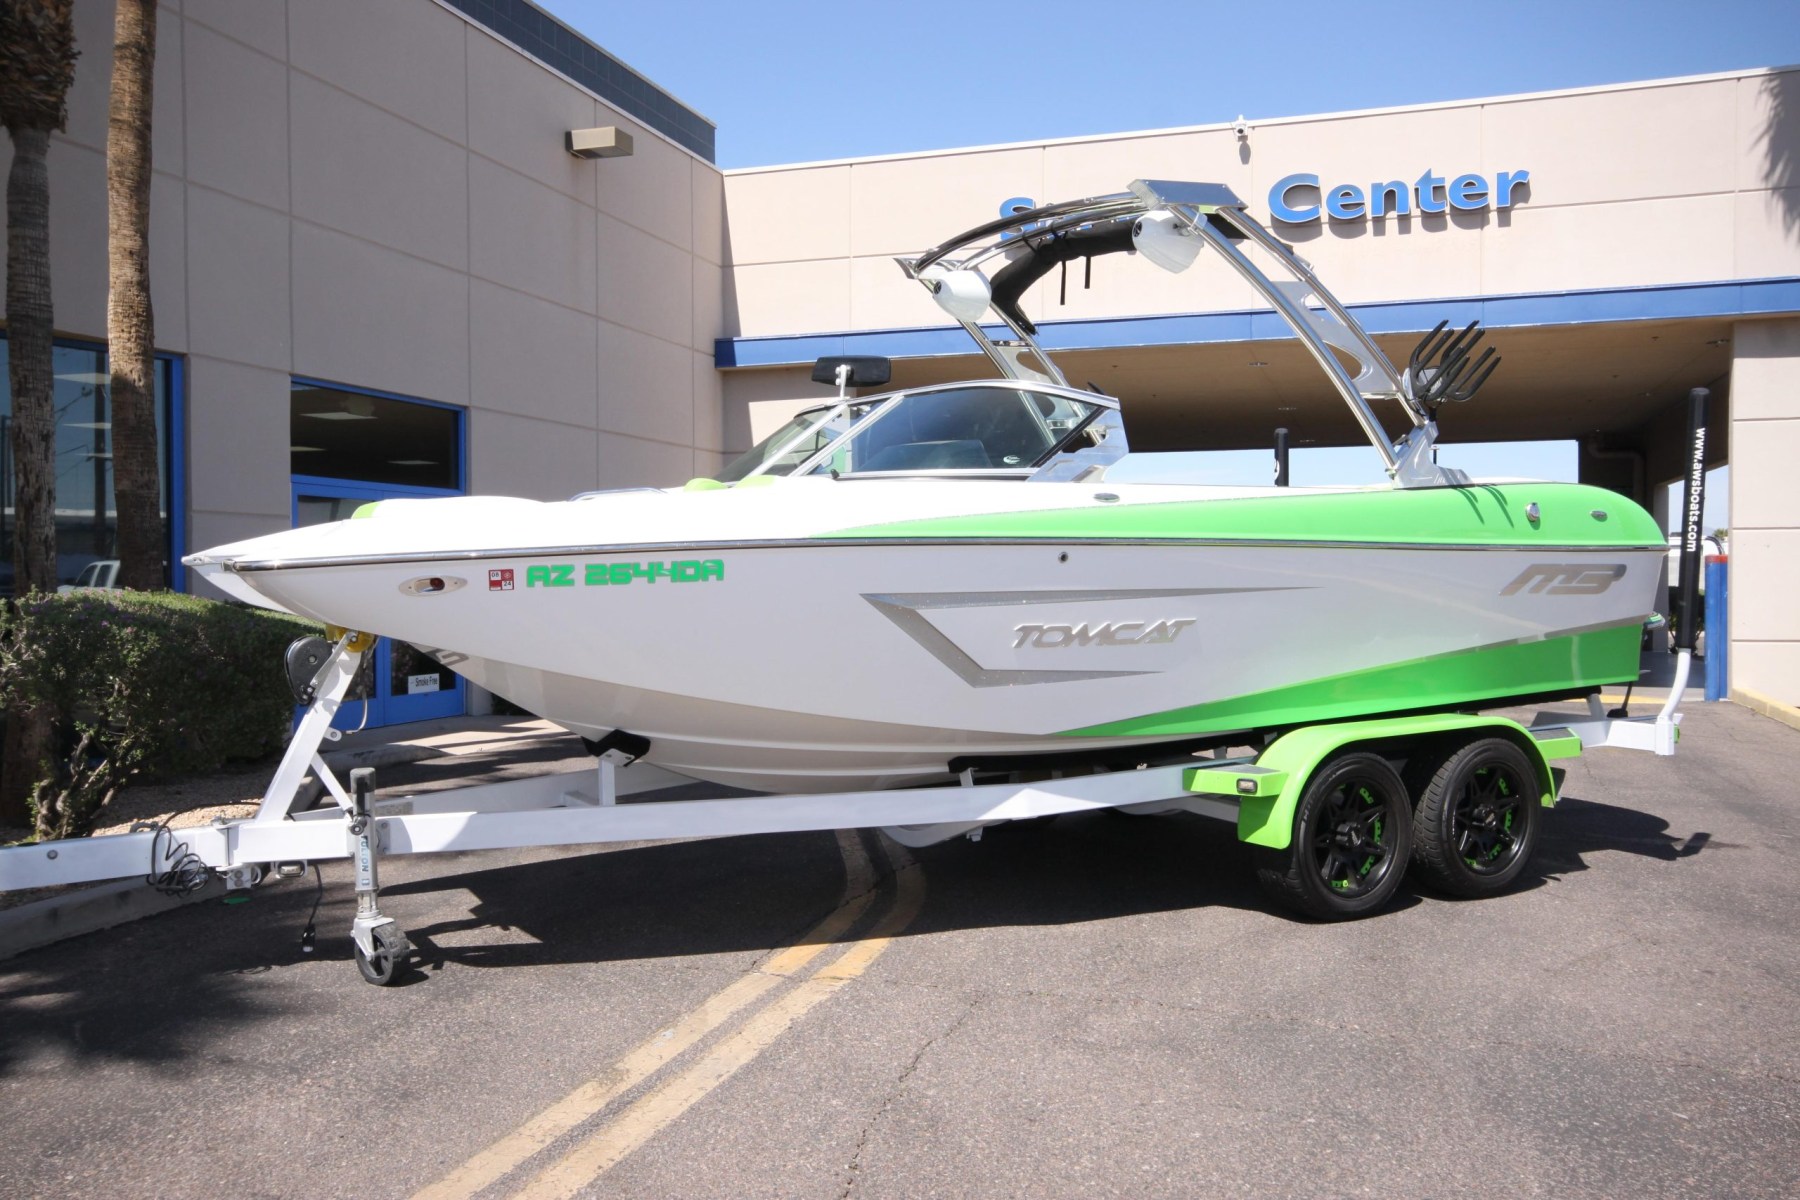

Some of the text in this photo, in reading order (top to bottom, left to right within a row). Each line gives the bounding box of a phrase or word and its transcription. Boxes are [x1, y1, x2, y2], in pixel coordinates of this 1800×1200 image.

[1268, 168, 1530, 223] Center
[1686, 427, 1706, 552] www.awsboats.com
[526, 559, 724, 588] AZ 2644DA
[1012, 617, 1197, 649] TOMCAT
[360, 835, 369, 872] FULTON
